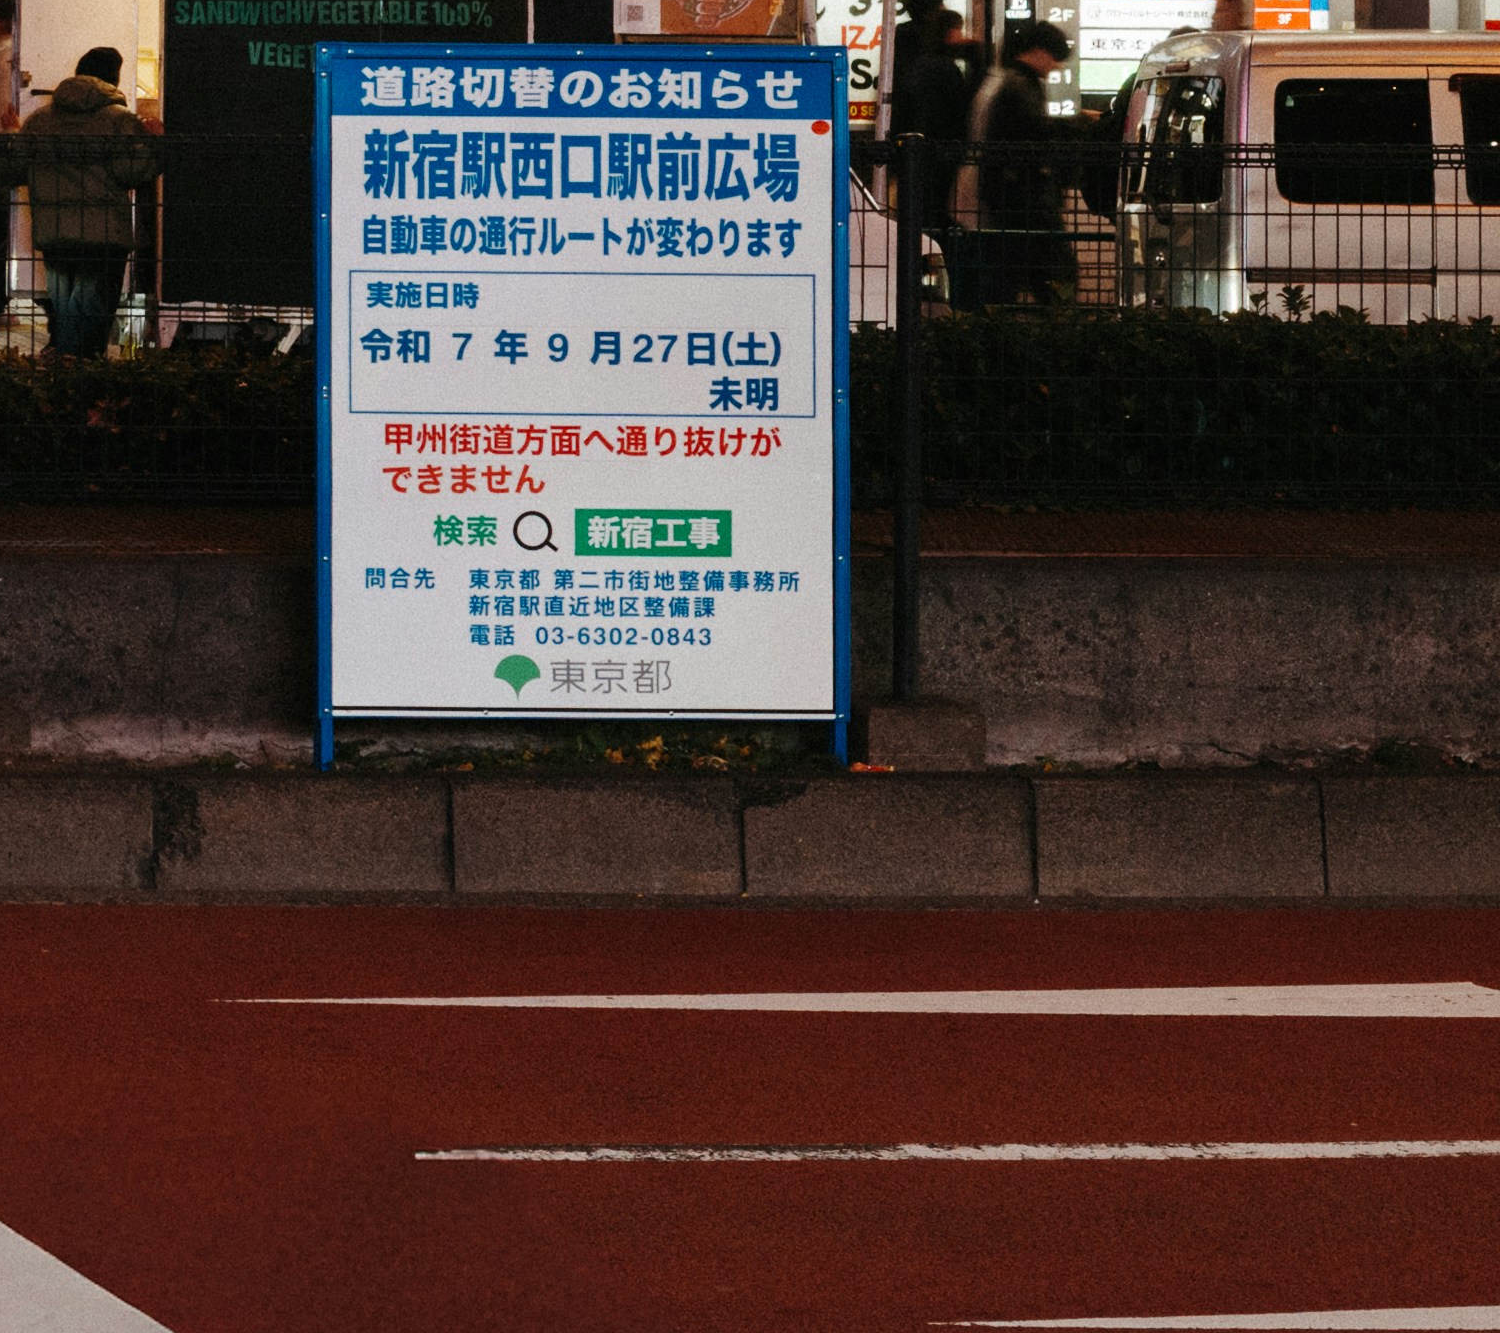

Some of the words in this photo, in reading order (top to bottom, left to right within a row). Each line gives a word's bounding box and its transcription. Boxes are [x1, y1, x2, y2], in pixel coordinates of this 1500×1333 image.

[173, 0, 301, 27] SANDWICH
[301, 0, 428, 26] VEGETABLE
[430, 0, 494, 29] 100%
[360, 66, 804, 111] 道路切替のお知らせ
[1048, 100, 1075, 115] B2
[363, 129, 802, 203] 新宿駅西口駅前広場
[361, 215, 803, 259] 自動車の通行ルートが変わります
[366, 281, 480, 310] 実施日時
[709, 376, 780, 412] 未明
[383, 423, 783, 460] 甲州街道方面へ通り抜けが
[382, 465, 546, 496] できません
[432, 514, 499, 547] 検索
[587, 516, 722, 551] 新宿工事
[365, 568, 436, 591] 問合先
[469, 569, 541, 591] 東京都
[553, 569, 802, 595] 第二市街地整備事務所
[468, 595, 717, 619] 新宿駅直近地区整備課
[468, 625, 517, 648] 電話
[534, 627, 713, 648] 03-6302-0843
[550, 658, 673, 695] 東京都
